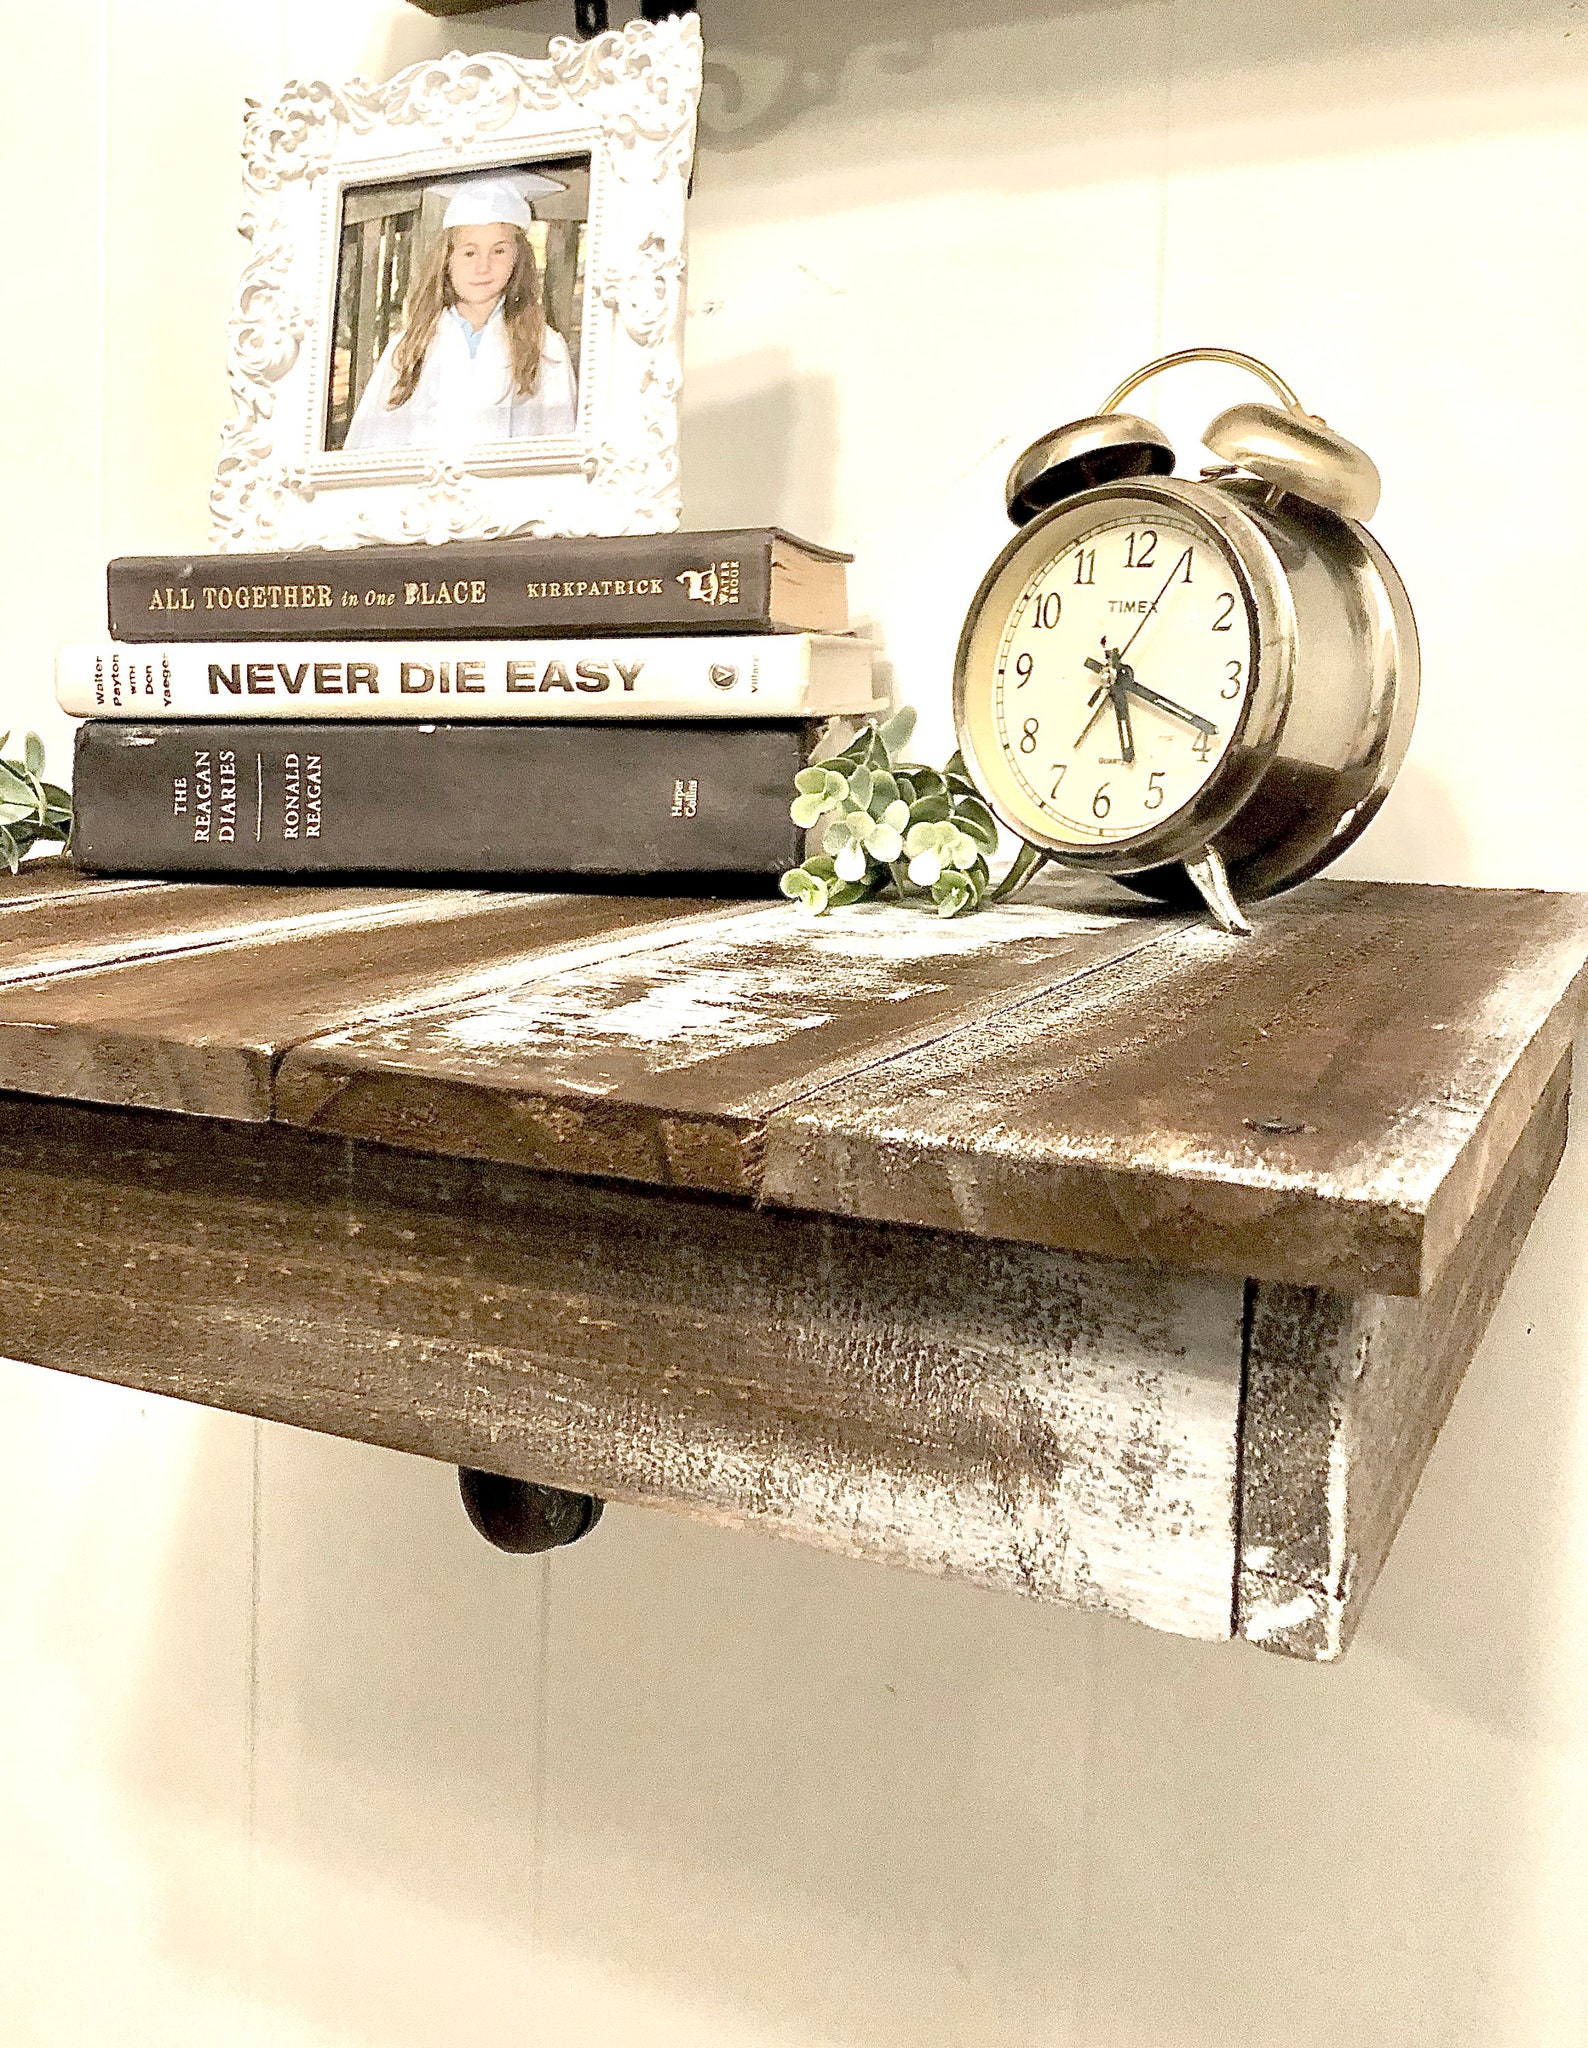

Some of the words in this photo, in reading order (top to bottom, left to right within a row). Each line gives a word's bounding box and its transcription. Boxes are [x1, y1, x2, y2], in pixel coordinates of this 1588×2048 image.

[1073, 549, 1096, 585] 11
[1123, 530, 1158, 568] 12
[1180, 546, 1195, 583] 1
[149, 587, 195, 611] ALL
[203, 583, 334, 610] TOGETHER
[341, 590, 360, 607] in
[364, 589, 396, 606] One
[527, 579, 664, 599] KIRKPATRICK
[718, 561, 730, 606] WATER
[729, 561, 740, 604] BROOK
[1031, 592, 1061, 629] 10
[1108, 600, 1158, 614] TIMEX
[1211, 592, 1235, 631] 2
[94, 655, 105, 705] Walter
[111, 654, 122, 706] Payton
[145, 665, 154, 695] Don
[162, 652, 172, 707] Yaeger
[208, 662, 380, 695] NEVER
[400, 660, 486, 694] DIE
[506, 658, 646, 693] EASY
[1016, 653, 1034, 689] 9
[1220, 660, 1242, 700] 3
[1020, 717, 1039, 754] 8
[1191, 729, 1211, 762] 4
[174, 777, 188, 816] THE
[194, 750, 212, 843] REAGAN
[219, 750, 237, 843] DIARIES
[284, 753, 300, 840] RONALD
[306, 755, 322, 838] REAGAN
[1050, 764, 1068, 799] 7
[1092, 782, 1111, 818] 6
[1144, 771, 1166, 809] 5
